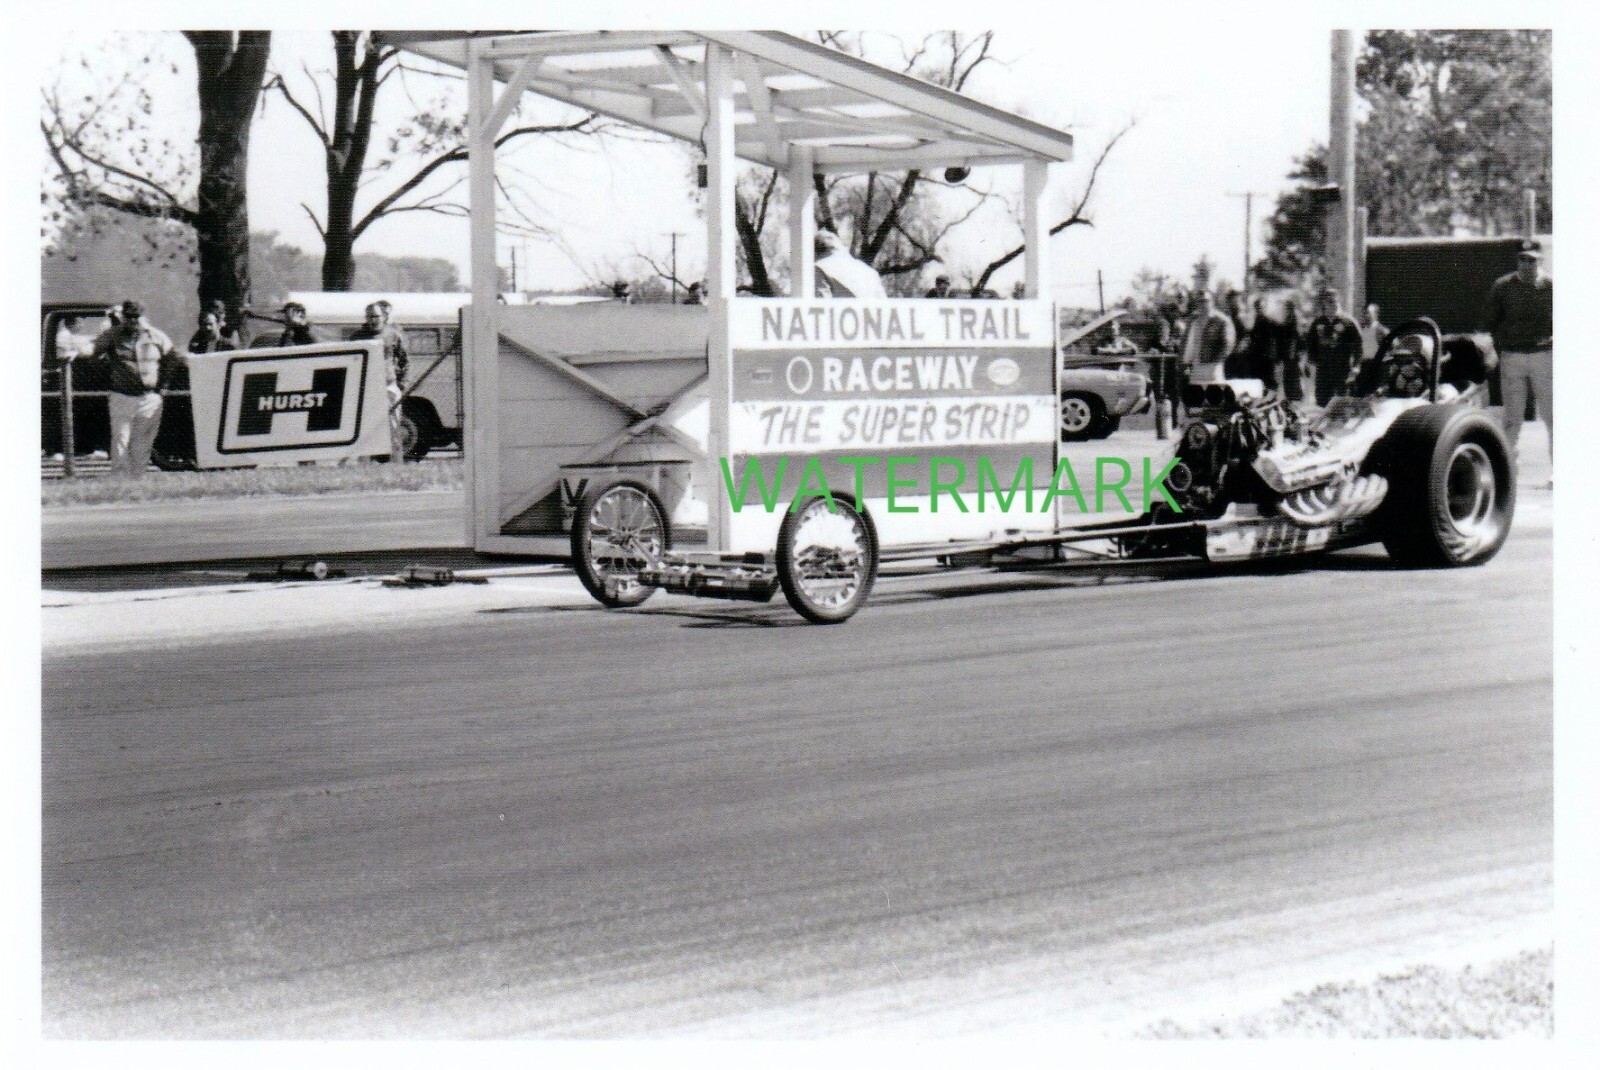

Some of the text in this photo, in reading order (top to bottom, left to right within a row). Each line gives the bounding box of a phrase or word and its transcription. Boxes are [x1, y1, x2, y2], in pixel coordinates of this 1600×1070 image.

[762, 306, 1031, 342] NATIONAL TRAIL
[822, 355, 979, 393] RACEWAY
[258, 392, 328, 411] HURST
[839, 403, 938, 444] SUPER
